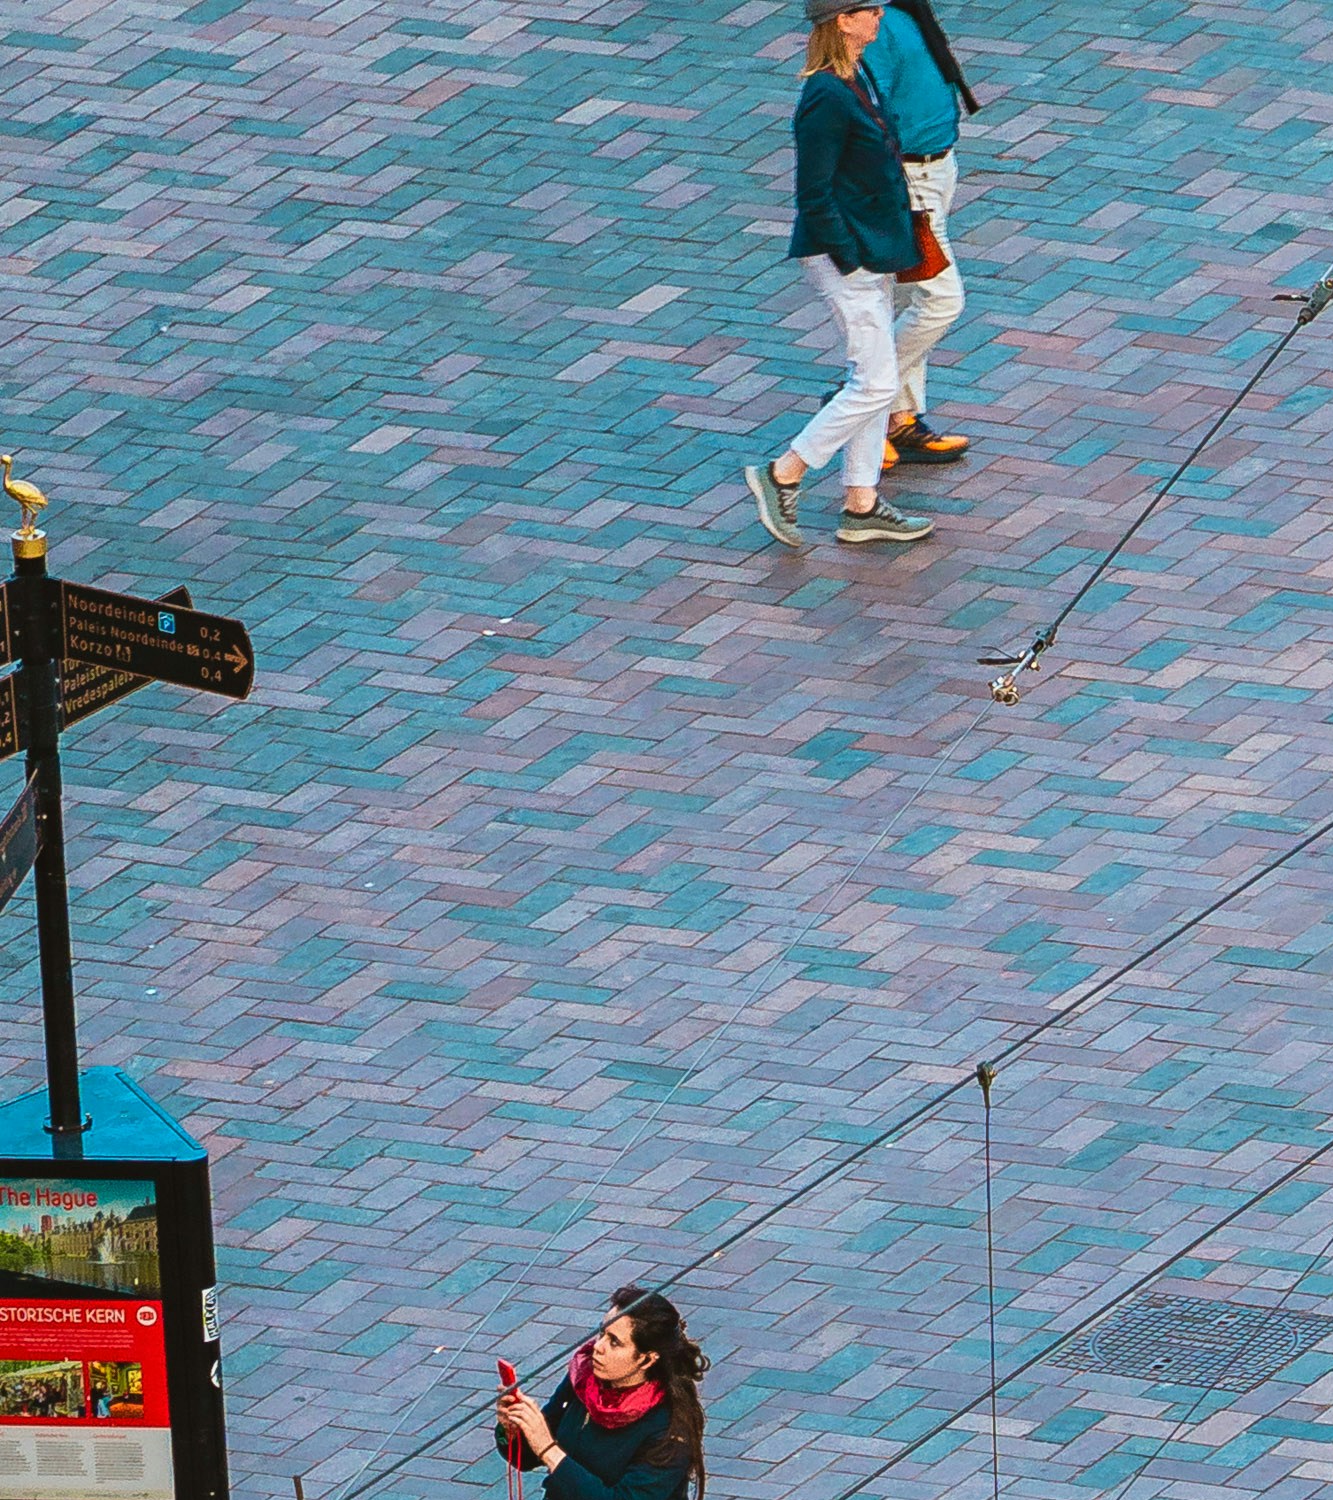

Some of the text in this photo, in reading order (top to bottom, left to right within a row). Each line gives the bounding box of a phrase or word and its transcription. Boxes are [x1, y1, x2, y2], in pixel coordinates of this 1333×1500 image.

[68, 593, 155, 626] Noordeinde
[200, 626, 221, 642] 0,2
[69, 616, 221, 662] Paleis Noordeinde 0,4
[70, 634, 222, 682] Korzo 0,4
[65, 673, 134, 714] Vredespaleis
[36, 1187, 98, 1211] Hague
[85, 1308, 126, 1323] KERN
